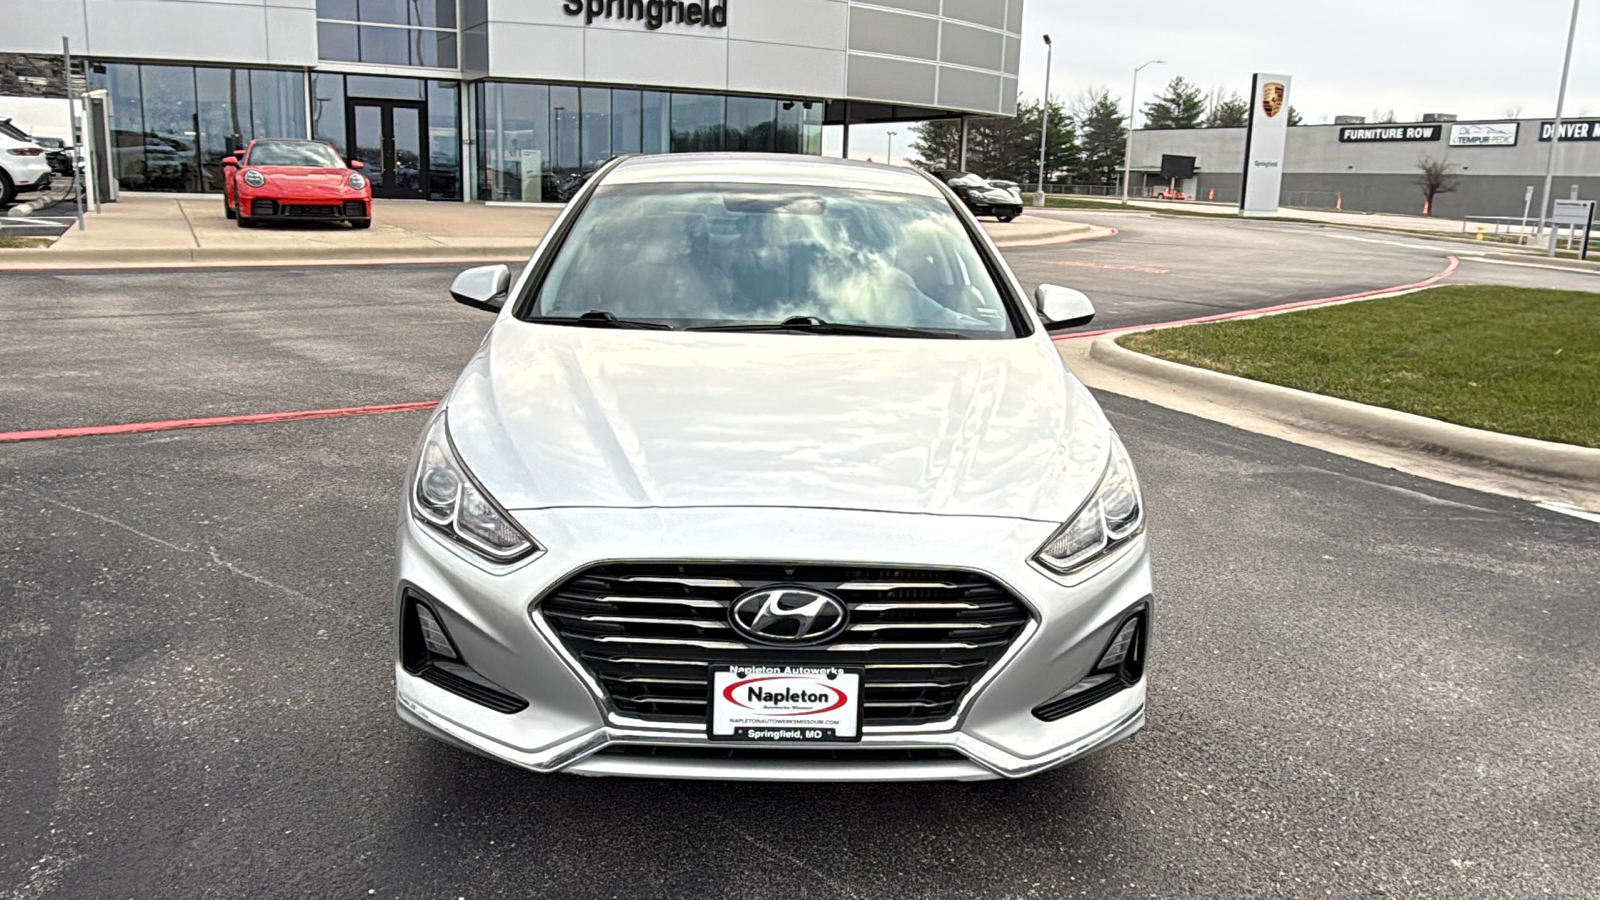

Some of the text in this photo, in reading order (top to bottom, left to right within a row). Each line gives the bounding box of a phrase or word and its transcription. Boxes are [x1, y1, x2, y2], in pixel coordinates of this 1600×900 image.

[563, 0, 727, 30] Springfield
[1343, 127, 1434, 140] FURNITURE ROW
[729, 665, 845, 676] Napleton Autowerks
[748, 687, 829, 705] Napleton
[747, 729, 822, 740] Springfield, MO
